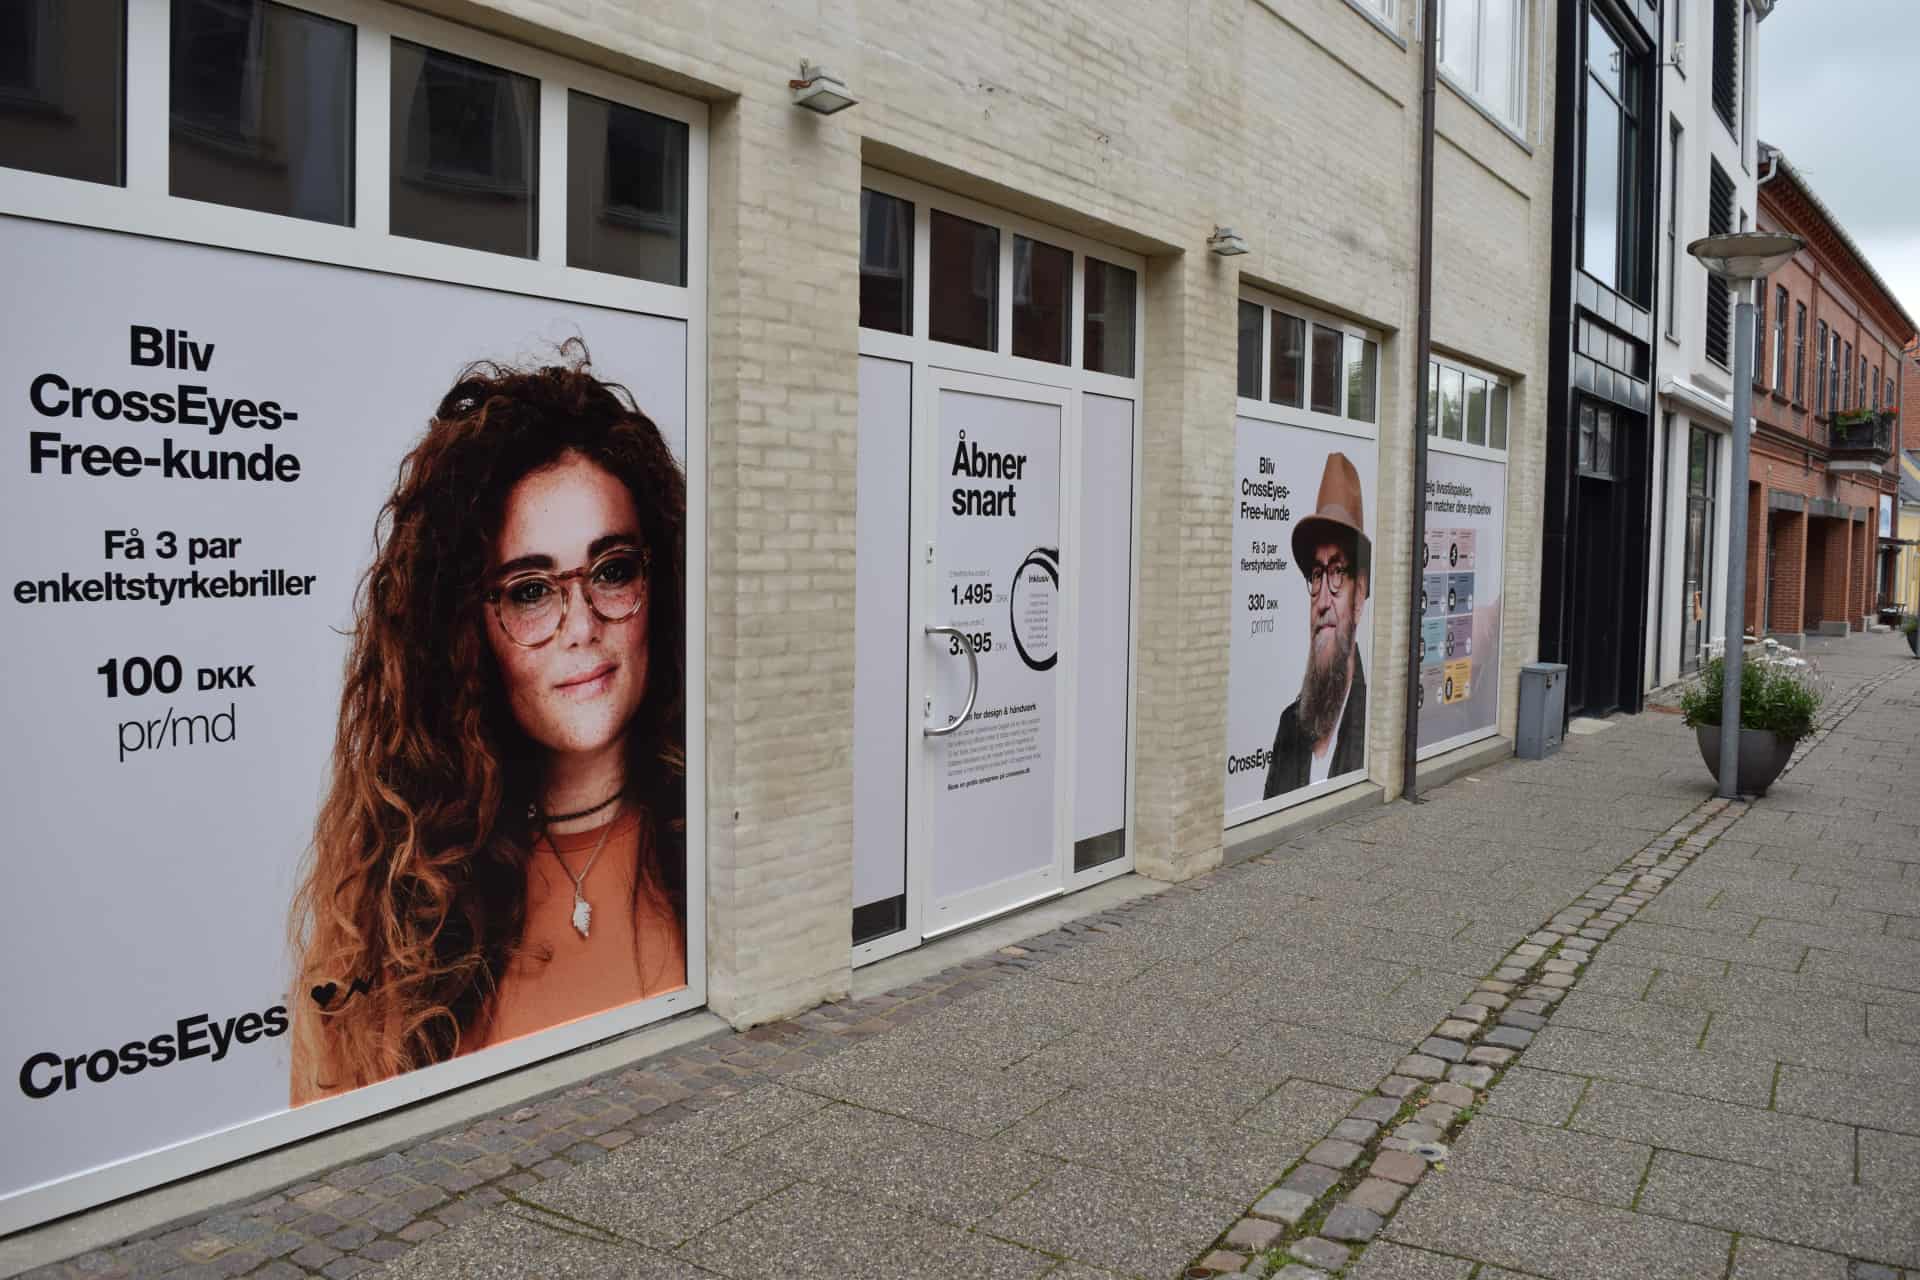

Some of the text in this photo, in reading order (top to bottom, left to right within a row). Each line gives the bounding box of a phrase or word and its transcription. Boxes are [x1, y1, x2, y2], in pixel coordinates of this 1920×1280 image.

[130, 325, 214, 372] Bliv
[30, 373, 298, 434] CrossEyes-
[30, 431, 300, 482] Free-kunde
[952, 429, 1027, 480] Åbner
[1259, 457, 1276, 475] Bliv
[952, 484, 1016, 517] snart
[1241, 478, 1290, 502] CrossEyes-
[1240, 502, 1290, 522] Free-kunde
[104, 528, 242, 565] Få 3 par
[1261, 542, 1266, 554] 3
[1267, 544, 1279, 556] par
[14, 569, 316, 606] enkeltstyrkebriller
[951, 583, 993, 606] 1.495
[1248, 594, 1265, 611] 330
[97, 655, 256, 698] 100 DKK
[118, 703, 236, 762] pr/md
[1228, 748, 1273, 775] CrossEye
[19, 1005, 289, 1099] CrossEyes
